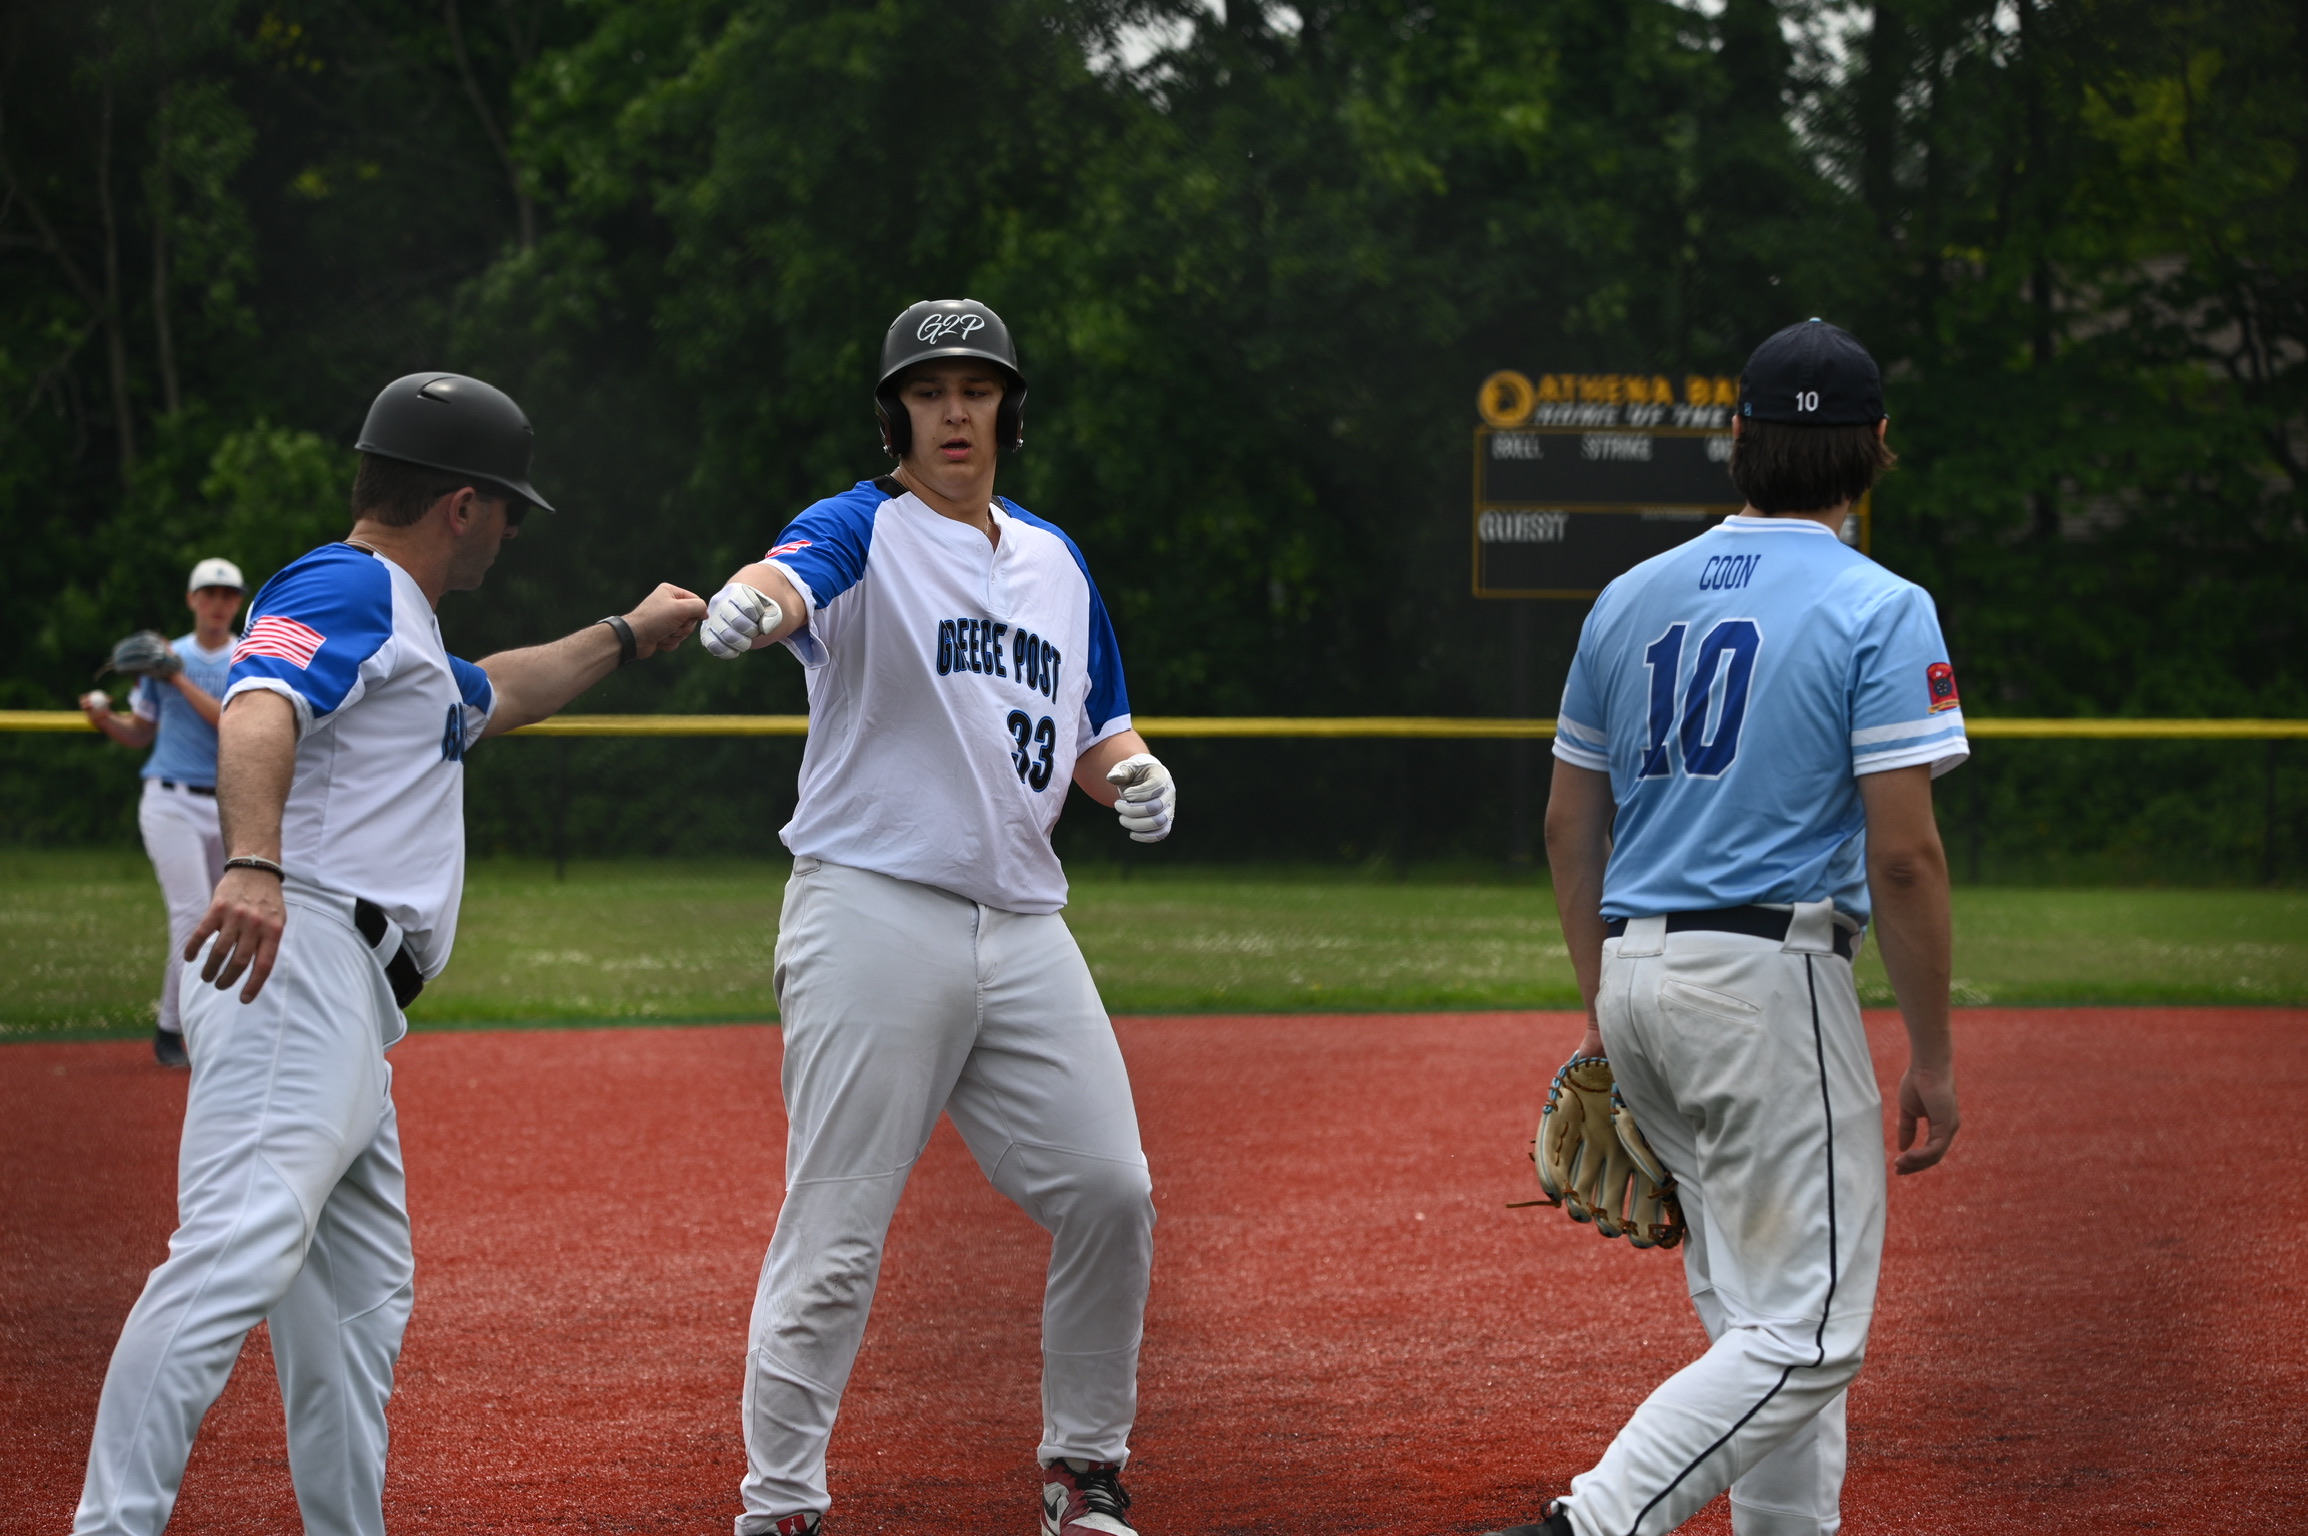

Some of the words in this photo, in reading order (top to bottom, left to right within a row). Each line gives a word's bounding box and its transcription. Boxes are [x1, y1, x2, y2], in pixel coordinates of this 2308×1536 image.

[916, 313, 985, 345] G2P
[1538, 373, 1675, 406] ATHENA
[1685, 375, 1741, 407] BA
[1795, 391, 1820, 412] 10
[1535, 402, 1619, 427] HOME
[1627, 403, 1666, 428] OF
[1673, 403, 1728, 429] THE
[1491, 432, 1543, 460] BALL
[1580, 432, 1653, 461] STRIKE
[1478, 510, 1569, 543] GUEST
[1699, 554, 1762, 591] COON
[1012, 627, 1062, 706] POST
[1636, 617, 1764, 781] 10
[1006, 709, 1056, 793] 33
